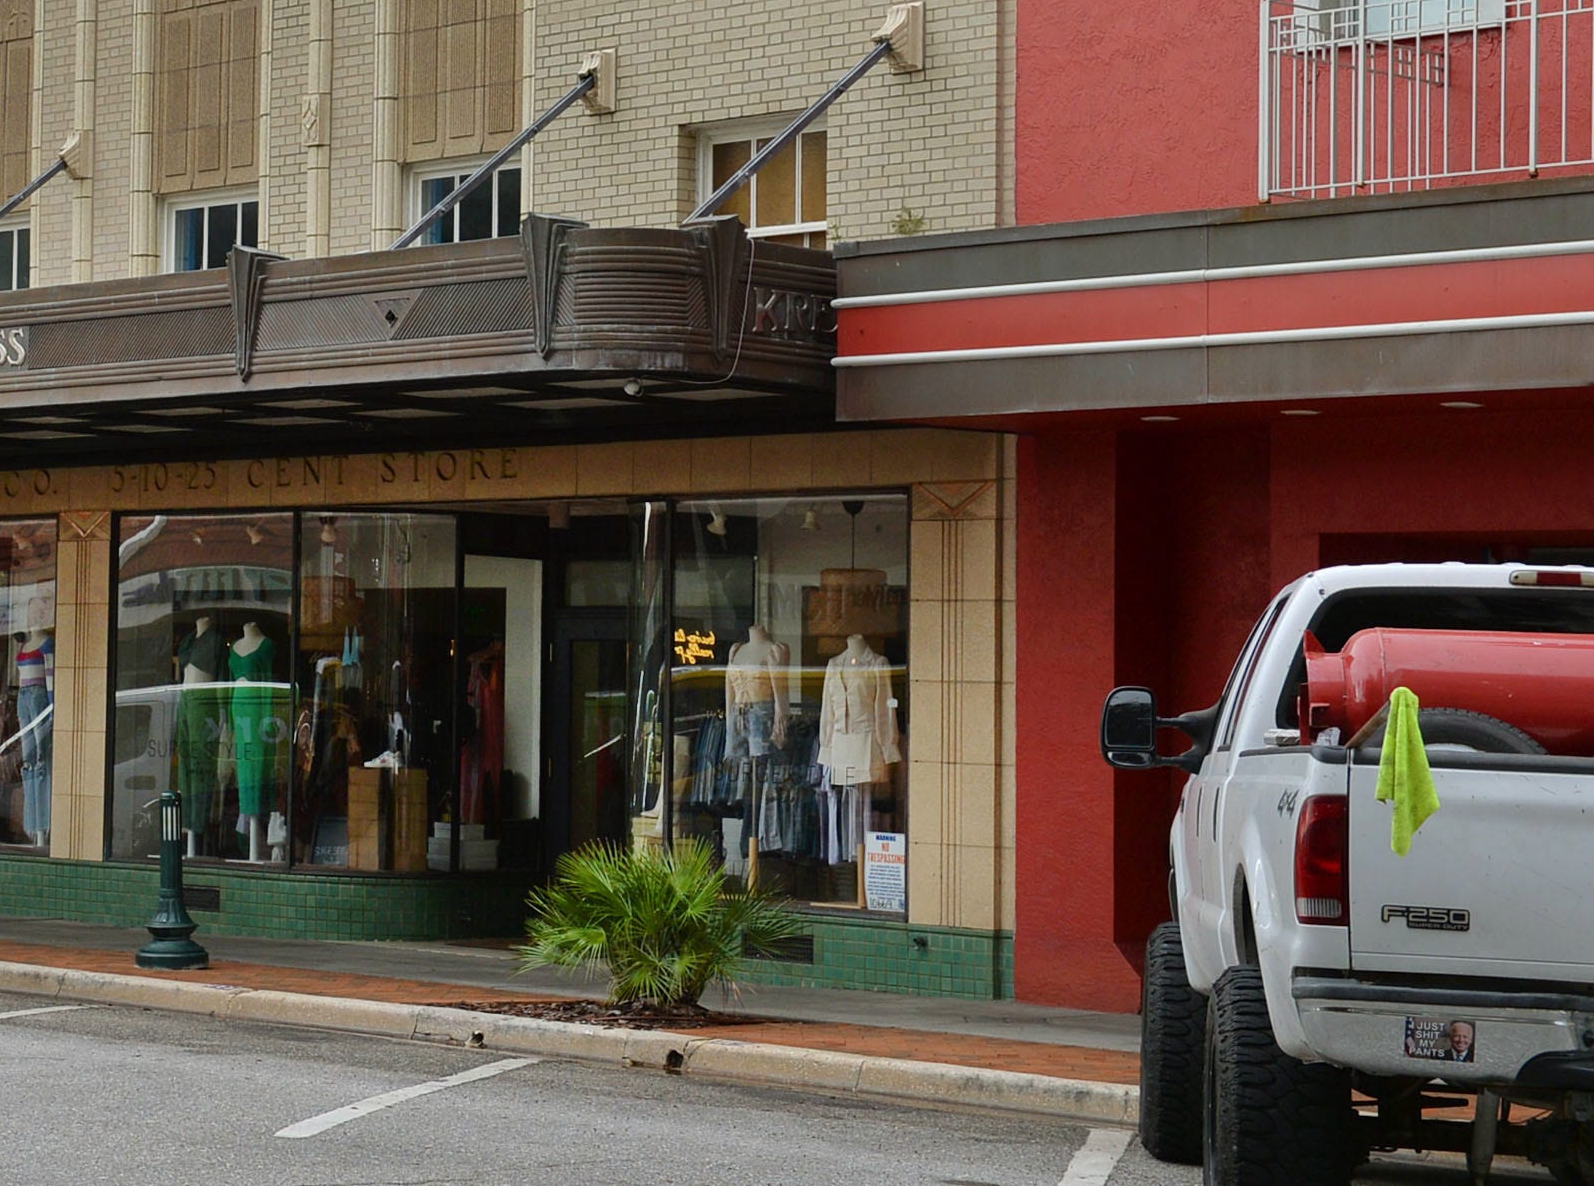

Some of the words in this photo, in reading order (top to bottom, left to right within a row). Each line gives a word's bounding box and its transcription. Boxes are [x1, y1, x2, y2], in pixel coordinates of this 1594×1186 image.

[246, 455, 350, 489] CENT
[380, 448, 519, 484] STORE
[1416, 1021, 1446, 1031] JUST
[1415, 1030, 1440, 1039] SHIT
[1419, 1039, 1436, 1047] MY
[1409, 1047, 1445, 1057] PANTS
